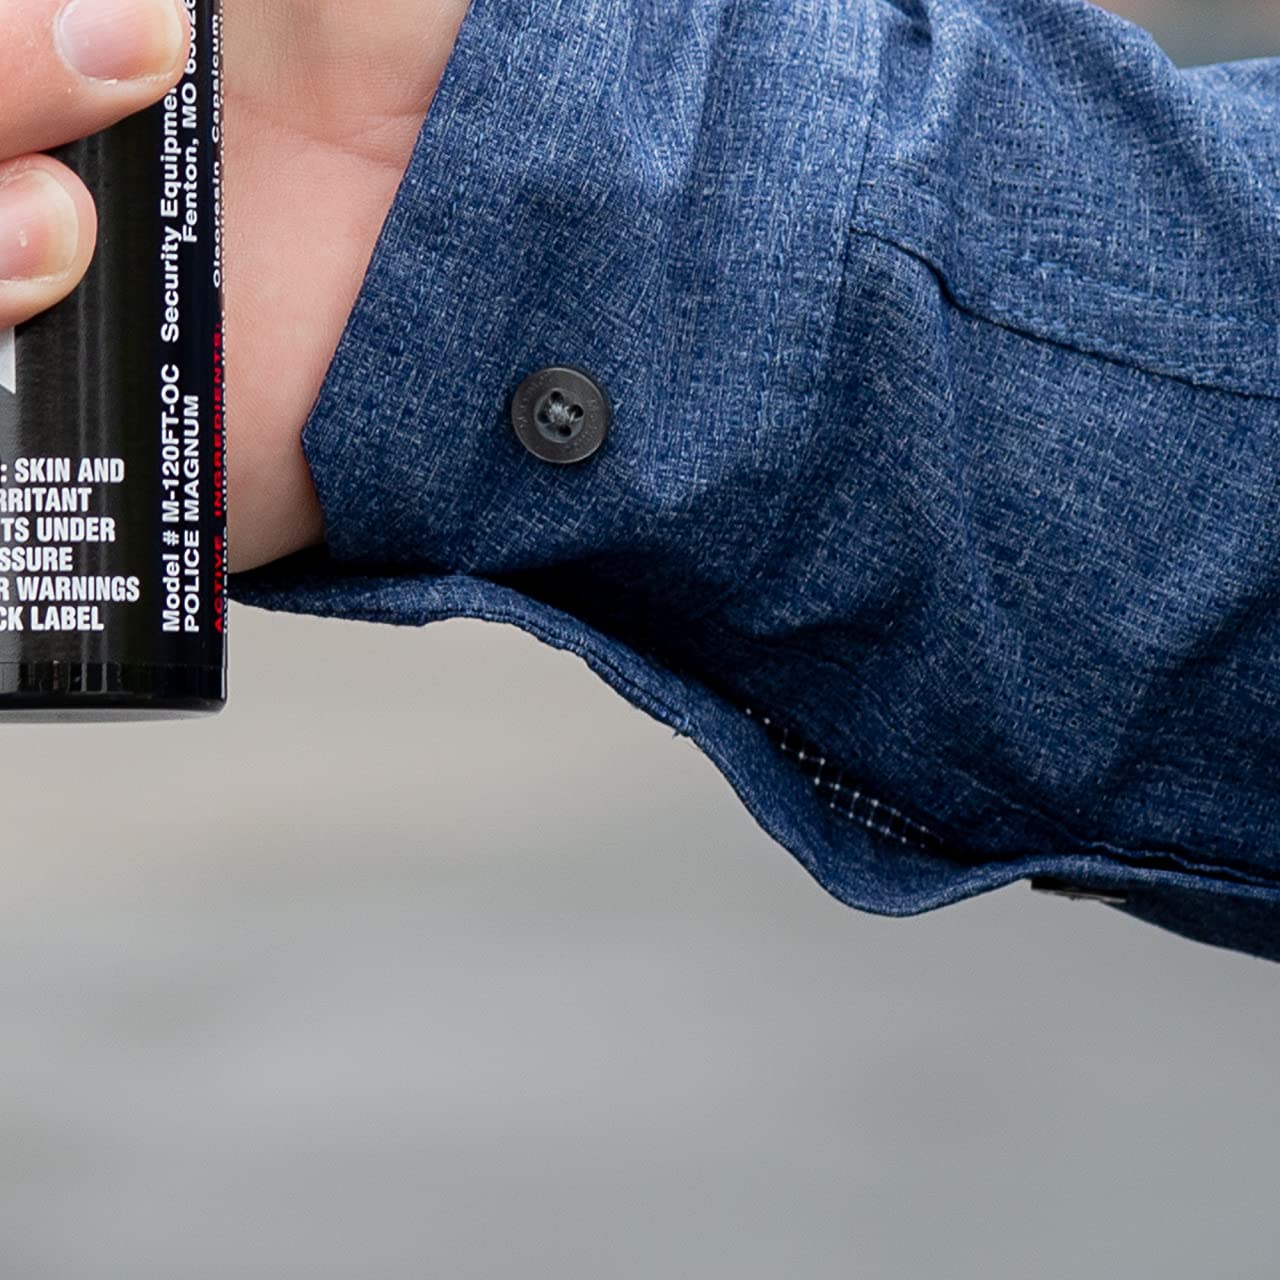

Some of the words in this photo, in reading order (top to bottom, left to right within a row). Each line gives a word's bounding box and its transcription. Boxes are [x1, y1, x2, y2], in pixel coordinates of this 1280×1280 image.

[182, 83, 196, 128] MO
[211, 14, 220, 144] Capsicum
[161, 86, 183, 218] Equipme
[181, 139, 198, 242] Fenton,
[212, 161, 220, 288] Oleoresin
[161, 226, 182, 342] Security
[15, 458, 70, 483] SKIN
[78, 458, 124, 482] AND
[161, 365, 179, 522] M-120FT-OC
[184, 396, 199, 521] MAGNUM
[37, 517, 115, 542] UNDER
[163, 531, 179, 545] #
[16, 576, 139, 601] WARNINGS
[31, 606, 104, 630] LABEL
[163, 554, 180, 631] Model
[184, 531, 199, 631] POLICE
[213, 533, 222, 633] ACTIVE
